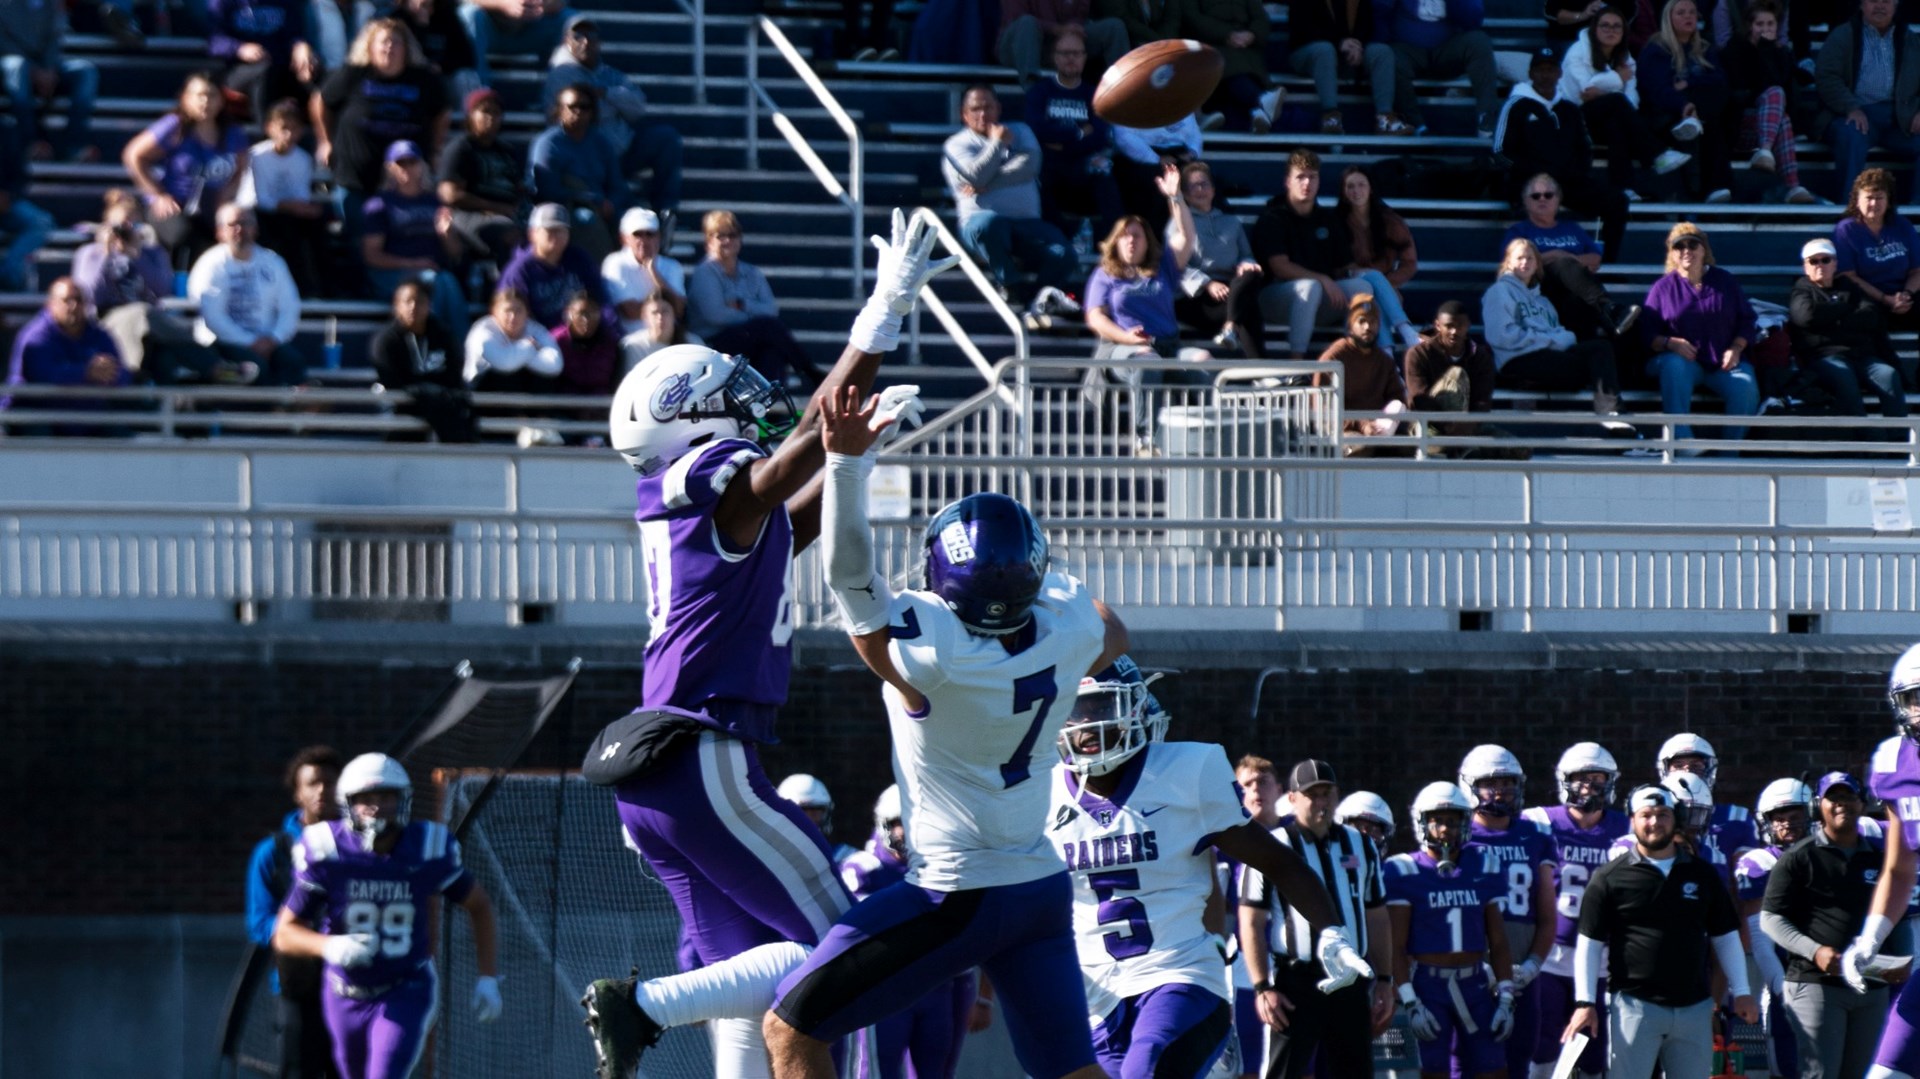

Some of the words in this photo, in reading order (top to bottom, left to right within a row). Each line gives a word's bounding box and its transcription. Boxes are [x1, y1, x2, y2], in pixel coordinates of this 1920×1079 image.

[1048, 106, 1088, 119] FOOTBALL
[1000, 664, 1058, 789] 7
[1063, 830, 1159, 871] RAIDERS
[1564, 845, 1608, 864] CAPITA
[349, 880, 414, 900] CAPITAL
[1429, 890, 1481, 908] CAPITAL
[345, 902, 415, 968] 89
[1087, 867, 1154, 962] 5
[1446, 908, 1463, 953] 1
